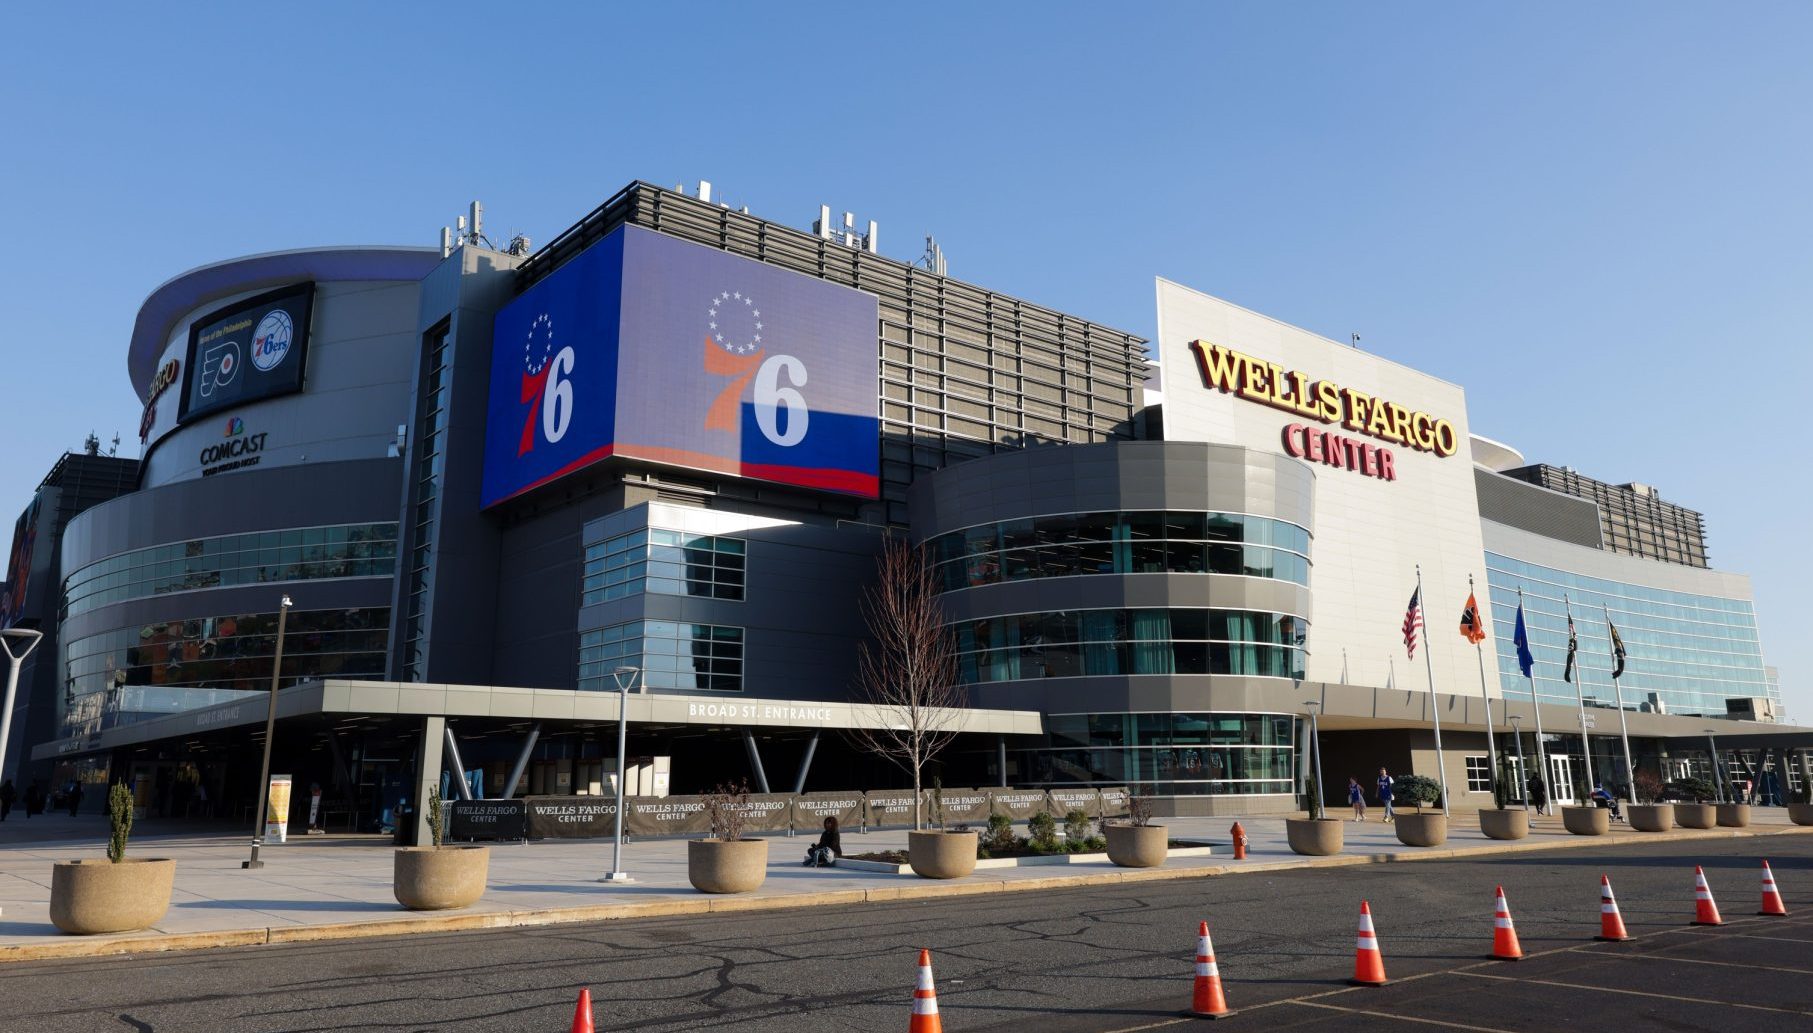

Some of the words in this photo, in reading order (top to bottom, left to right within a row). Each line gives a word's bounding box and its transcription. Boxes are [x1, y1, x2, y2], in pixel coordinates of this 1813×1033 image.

[255, 333, 288, 358] 76ers
[703, 335, 809, 447] 76
[518, 346, 575, 458] 76
[1195, 339, 1343, 424] WELLS
[1341, 387, 1458, 458] FARGO
[200, 433, 268, 465] COMCAST
[1282, 422, 1397, 482] CENTER
[240, 456, 261, 467] HOST
[689, 704, 737, 717] BROAD
[742, 706, 760, 718] ST.
[765, 707, 832, 720] ENTRANCE
[870, 799, 897, 807] WELLS
[940, 797, 960, 805] ELLS
[961, 796, 986, 804] FARGO
[996, 795, 1019, 803] WELLS
[1020, 794, 1042, 802] FARGO
[636, 804, 671, 813] WELLS
[673, 803, 706, 812] FARGO
[754, 802, 785, 810] FARGO
[798, 801, 828, 809] WELLS
[829, 800, 857, 808] FARGO
[456, 806, 485, 815] WELLS
[486, 805, 518, 815] FARGO
[535, 806, 576, 815] WELLS
[577, 805, 617, 814] FARGO
[471, 815, 497, 823] CENTER
[558, 815, 593, 823] CENTER
[656, 812, 686, 820] CENTER
